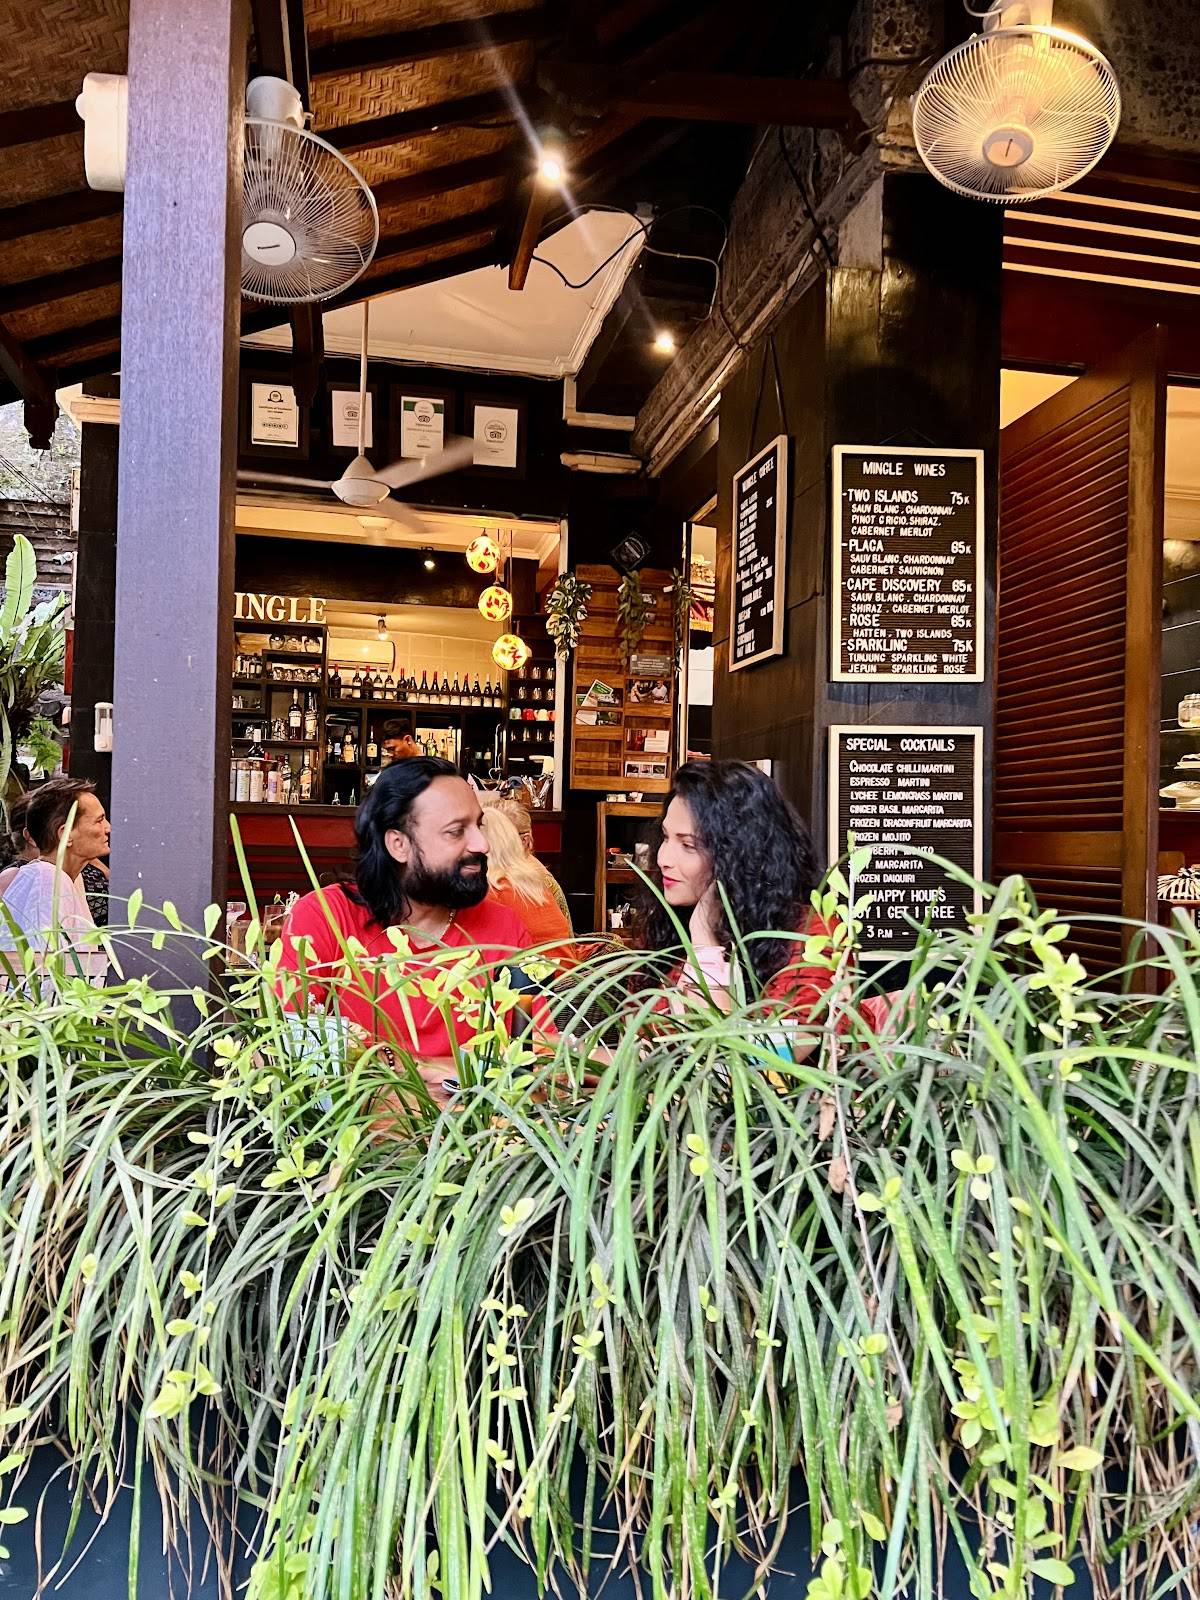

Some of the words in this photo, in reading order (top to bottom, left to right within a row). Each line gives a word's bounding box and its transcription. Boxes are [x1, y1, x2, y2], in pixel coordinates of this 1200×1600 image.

[863, 462, 903, 476] MINGLE
[914, 464, 945, 476] WINES
[875, 490, 918, 503] ISLANDS
[852, 504, 873, 514] SAUV
[852, 515, 874, 524] PINOT
[851, 526, 895, 536] CABERNET
[900, 527, 933, 536] MERLOT
[850, 554, 870, 563] SAUV
[850, 566, 894, 574] CABERNET
[899, 566, 944, 576] SAUVIGNON
[882, 579, 941, 592] DISCOVERY
[851, 593, 874, 601] SAUV
[876, 593, 904, 602] BLANC
[913, 594, 966, 603] CHARDONNAY
[234, 592, 326, 624] INGLE
[851, 604, 882, 613] SHIRAZ
[892, 605, 934, 614] CABERNET
[938, 605, 970, 614] MERLOT
[850, 614, 880, 626] ROSE
[853, 629, 886, 638] HATTEN
[895, 629, 913, 638] TWO
[916, 630, 952, 638] ISLANDS
[848, 654, 885, 662] TUNJUNG
[891, 654, 937, 662] SPARKLING
[942, 654, 968, 663] WHITE
[848, 665, 876, 673] JEPUN
[892, 665, 937, 673] SPARKLING
[944, 665, 965, 673] ROSE
[846, 738, 891, 751] SPECIAL
[900, 739, 955, 752] COCKTAILS
[850, 778, 890, 786] ESPRESSO
[898, 778, 930, 787] MARTINI
[851, 792, 878, 800] LYCHEE
[883, 792, 930, 800] LEMONGRASS
[933, 792, 963, 801] MARTINI
[850, 806, 877, 814] GINGER
[879, 806, 901, 814] BASIL
[902, 806, 944, 814] MARGARITA
[850, 819, 880, 828] FROZEN
[933, 819, 972, 828] MARGARITA
[851, 832, 879, 841] ROZEN
[882, 833, 911, 842] MOJITO
[875, 860, 923, 869] MARGARITA
[850, 874, 880, 883] ROZEN
[883, 874, 915, 883] DAIQUIRI
[868, 890, 907, 902] HAPPY
[850, 906, 871, 919] UY
[887, 906, 909, 919] GET
[924, 906, 955, 919] FREE
[867, 926, 874, 938] 3
